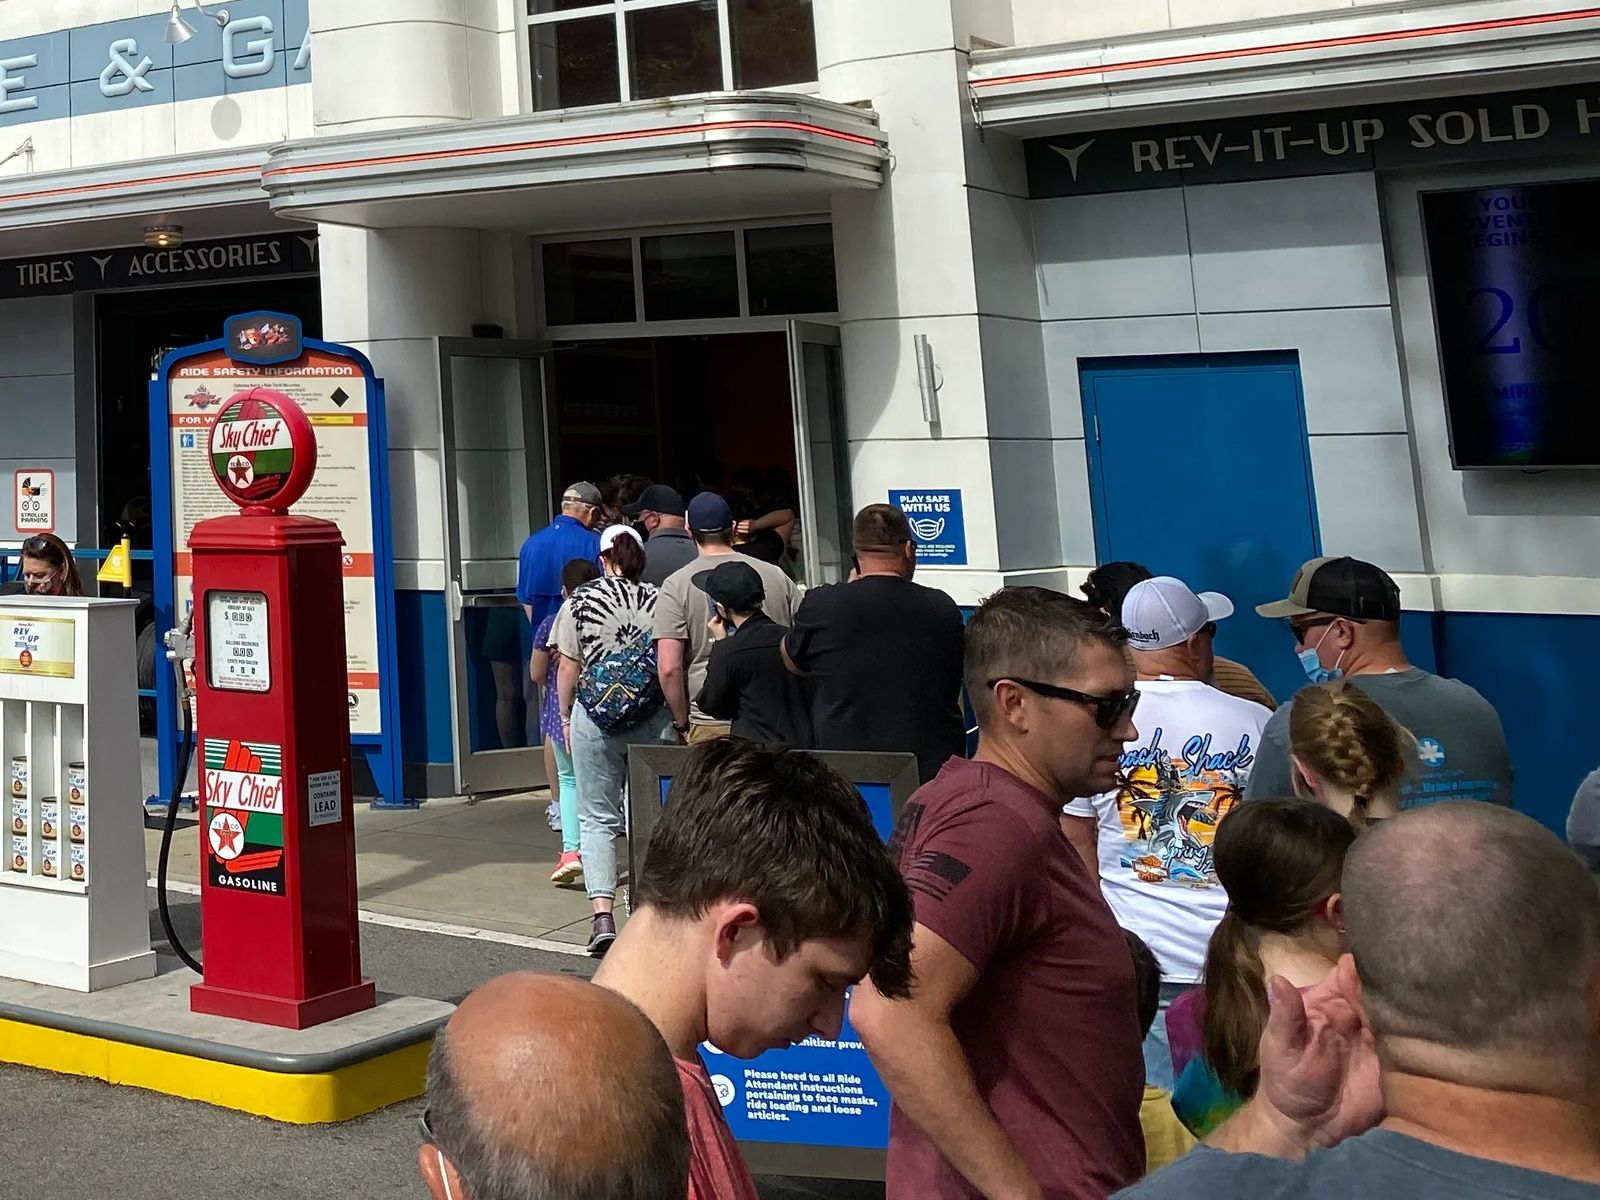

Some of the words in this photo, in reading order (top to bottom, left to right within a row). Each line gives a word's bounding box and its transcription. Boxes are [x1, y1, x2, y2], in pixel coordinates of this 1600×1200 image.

[99, 37, 155, 99] &
[1130, 117, 1385, 173] REV-IT-UP
[1407, 103, 1550, 149] SOLD
[16, 260, 75, 286] TIRES
[128, 241, 282, 277] ACCESSORIES
[180, 367, 210, 377] RIDE
[213, 366, 261, 377] SAFETY
[264, 365, 353, 376] INFORMATION
[178, 416, 201, 425] FOR
[219, 422, 242, 451] Sky
[242, 420, 281, 448] Chief
[899, 495, 924, 503] PLAY
[925, 495, 951, 503] SAFE
[901, 503, 933, 513] WITH
[934, 503, 951, 513] US
[13, 627, 30, 636] REV
[27, 635, 40, 643] UP
[1181, 731, 1255, 778] Shack
[206, 770, 233, 808] Sky
[238, 774, 283, 810] Chief
[312, 790, 337, 800] CONTAINS
[314, 800, 337, 813] LEAD
[214, 820, 240, 830] TECO
[1161, 837, 1209, 871] Spring
[218, 874, 278, 892] GASOLINE
[791, 1036, 837, 1048] nitizer
[838, 1040, 866, 1050] prov
[744, 1069, 779, 1080] Please
[780, 1071, 807, 1081] heed
[808, 1073, 820, 1082] to
[822, 1073, 836, 1083] all
[837, 1074, 861, 1084] Ride
[744, 1079, 798, 1092] Attendant
[800, 1082, 863, 1095] instructions
[746, 1090, 800, 1103] pertaining
[802, 1093, 814, 1102] to
[815, 1093, 839, 1103] face
[840, 1094, 878, 1107] masks,
[746, 1100, 768, 1110] ride
[769, 1102, 809, 1114] loading
[811, 1103, 832, 1113] and
[833, 1104, 862, 1115] loose
[747, 1111, 790, 1122] articles.
